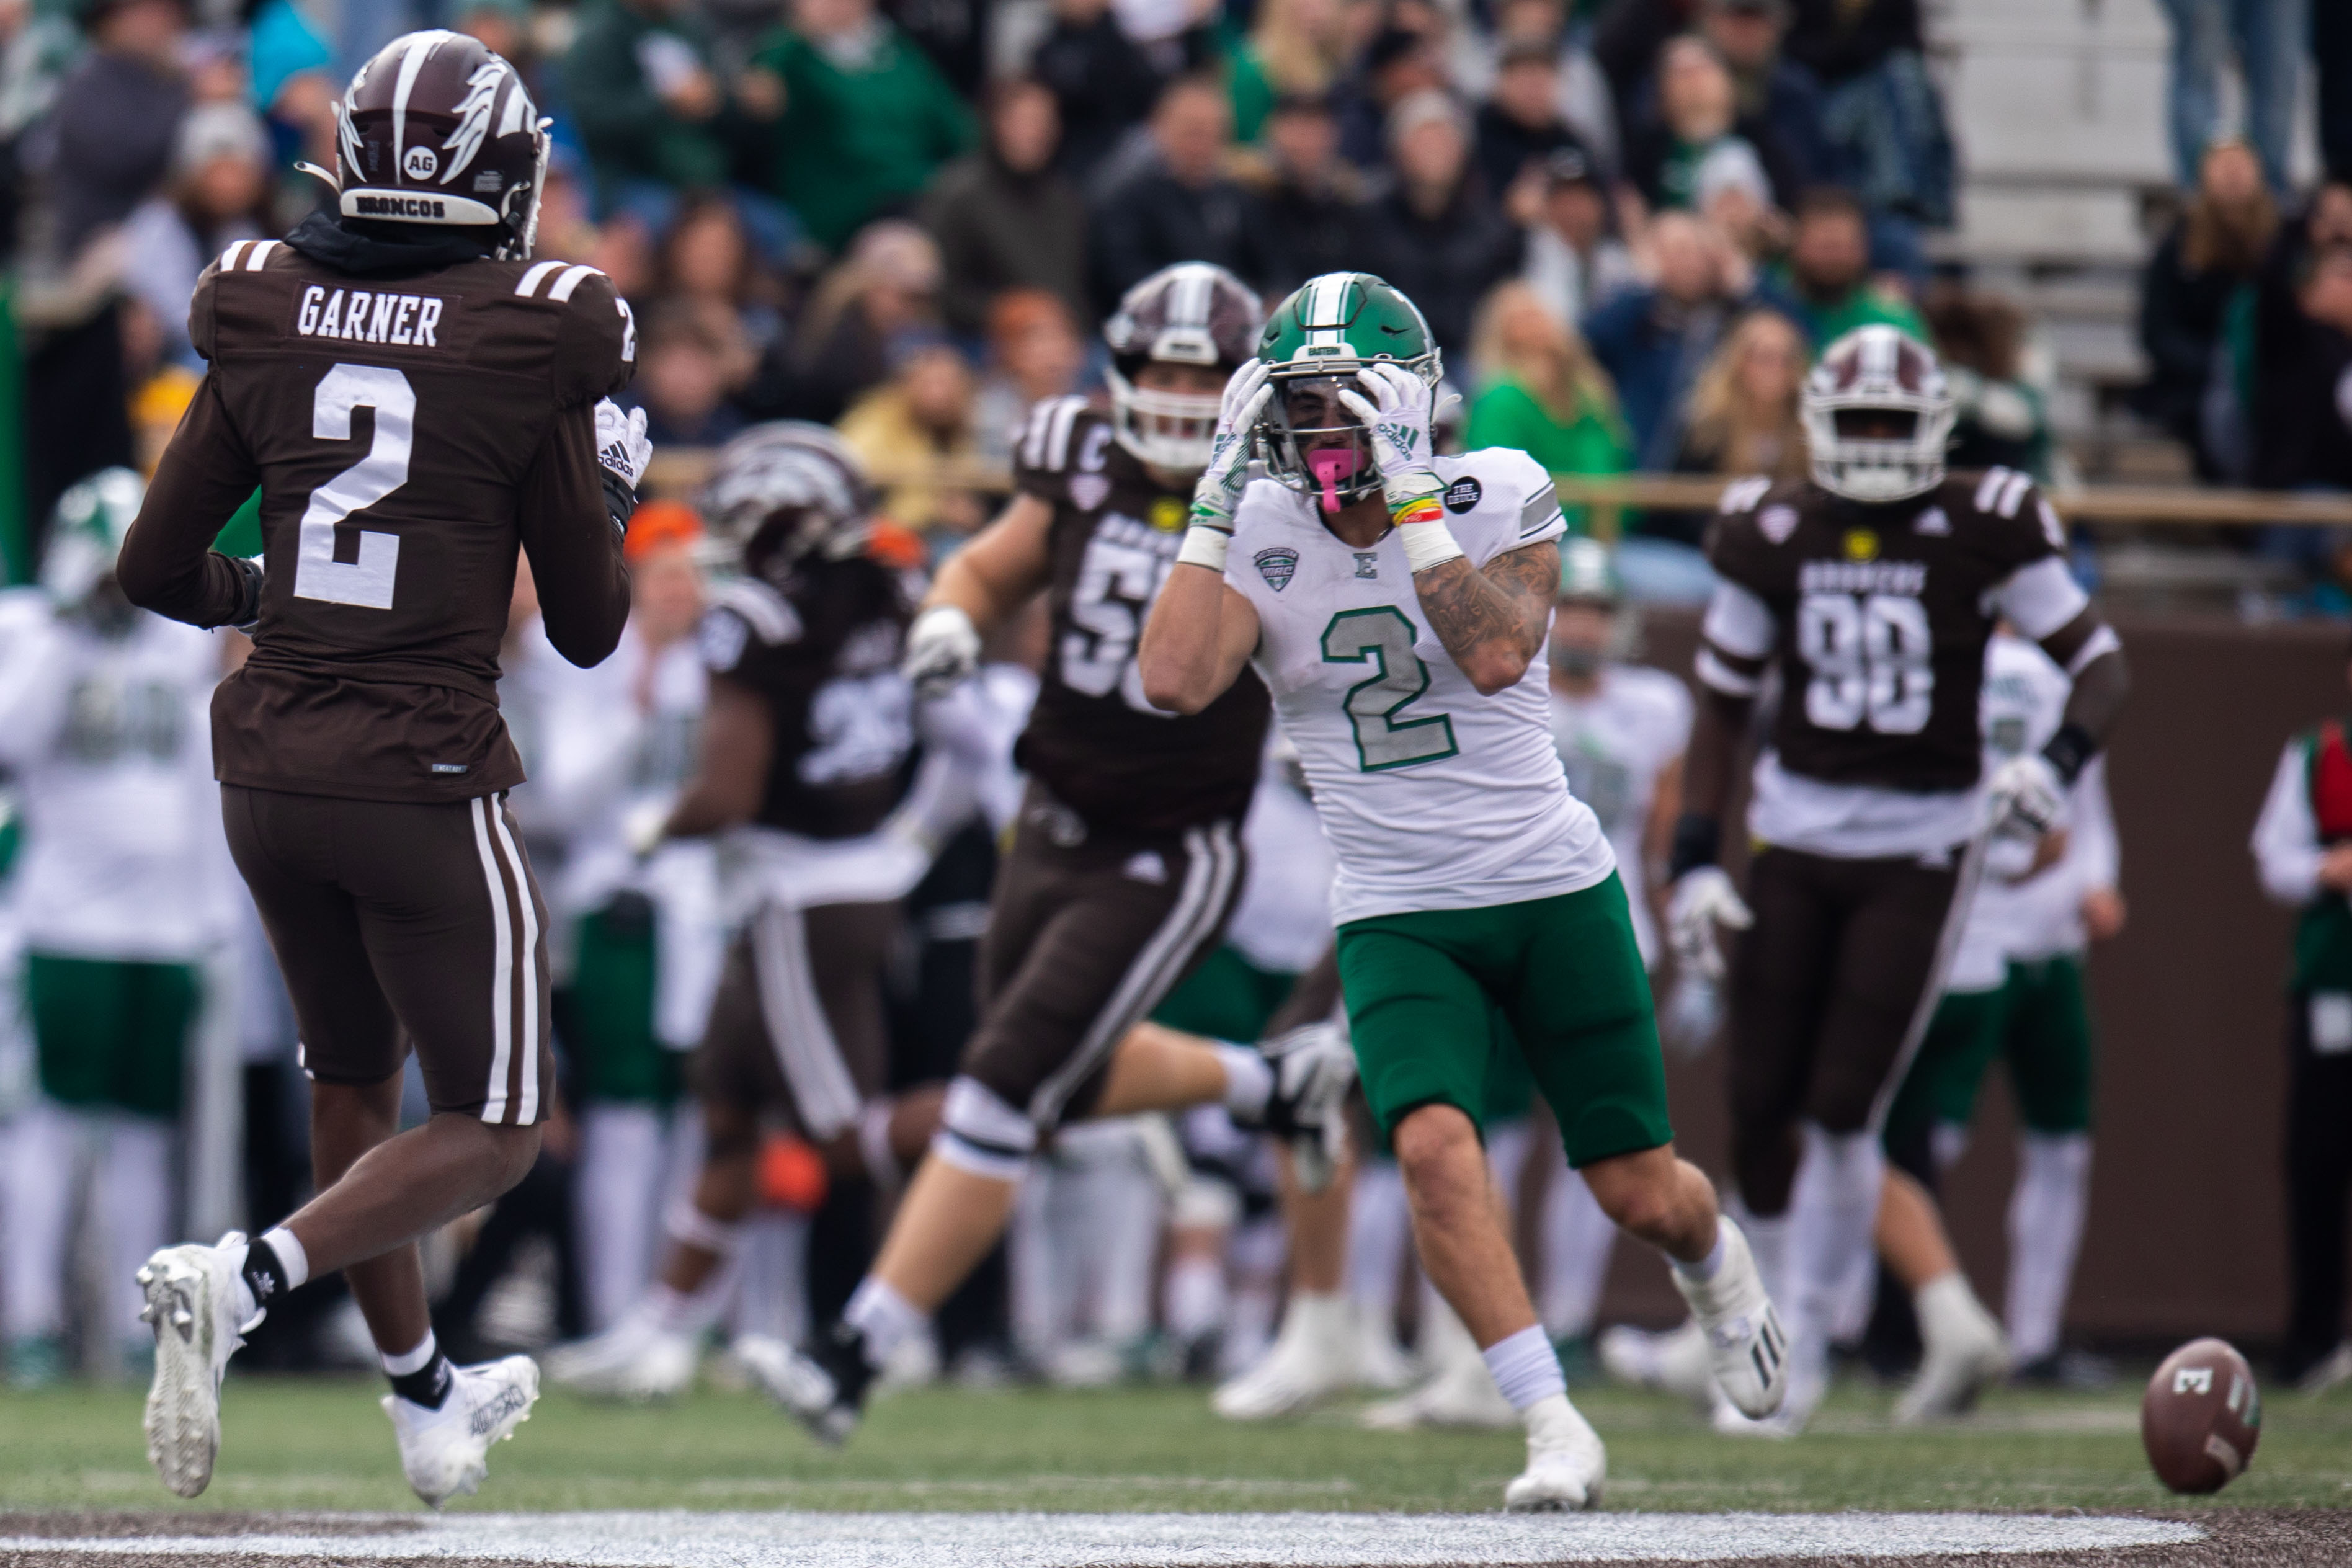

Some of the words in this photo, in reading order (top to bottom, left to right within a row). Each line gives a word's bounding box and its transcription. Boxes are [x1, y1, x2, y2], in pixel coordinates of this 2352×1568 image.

[408, 156, 433, 171] AG
[356, 197, 445, 218] BRONCOS
[298, 285, 443, 347] GARNER
[615, 298, 635, 362] 2
[1309, 347, 1341, 356] EASTERN
[1079, 423, 1113, 473] C
[1378, 423, 1414, 461] adidas
[597, 455, 634, 477] adidas
[293, 363, 417, 610] 2
[1446, 492, 1479, 506] DEUCE
[1453, 484, 1474, 494] THE
[1262, 566, 1294, 577] MAC
[1353, 552, 1378, 579] E
[1796, 593, 1934, 736] 90
[1320, 604, 1460, 773] 2
[2173, 1368, 2214, 1394] E
